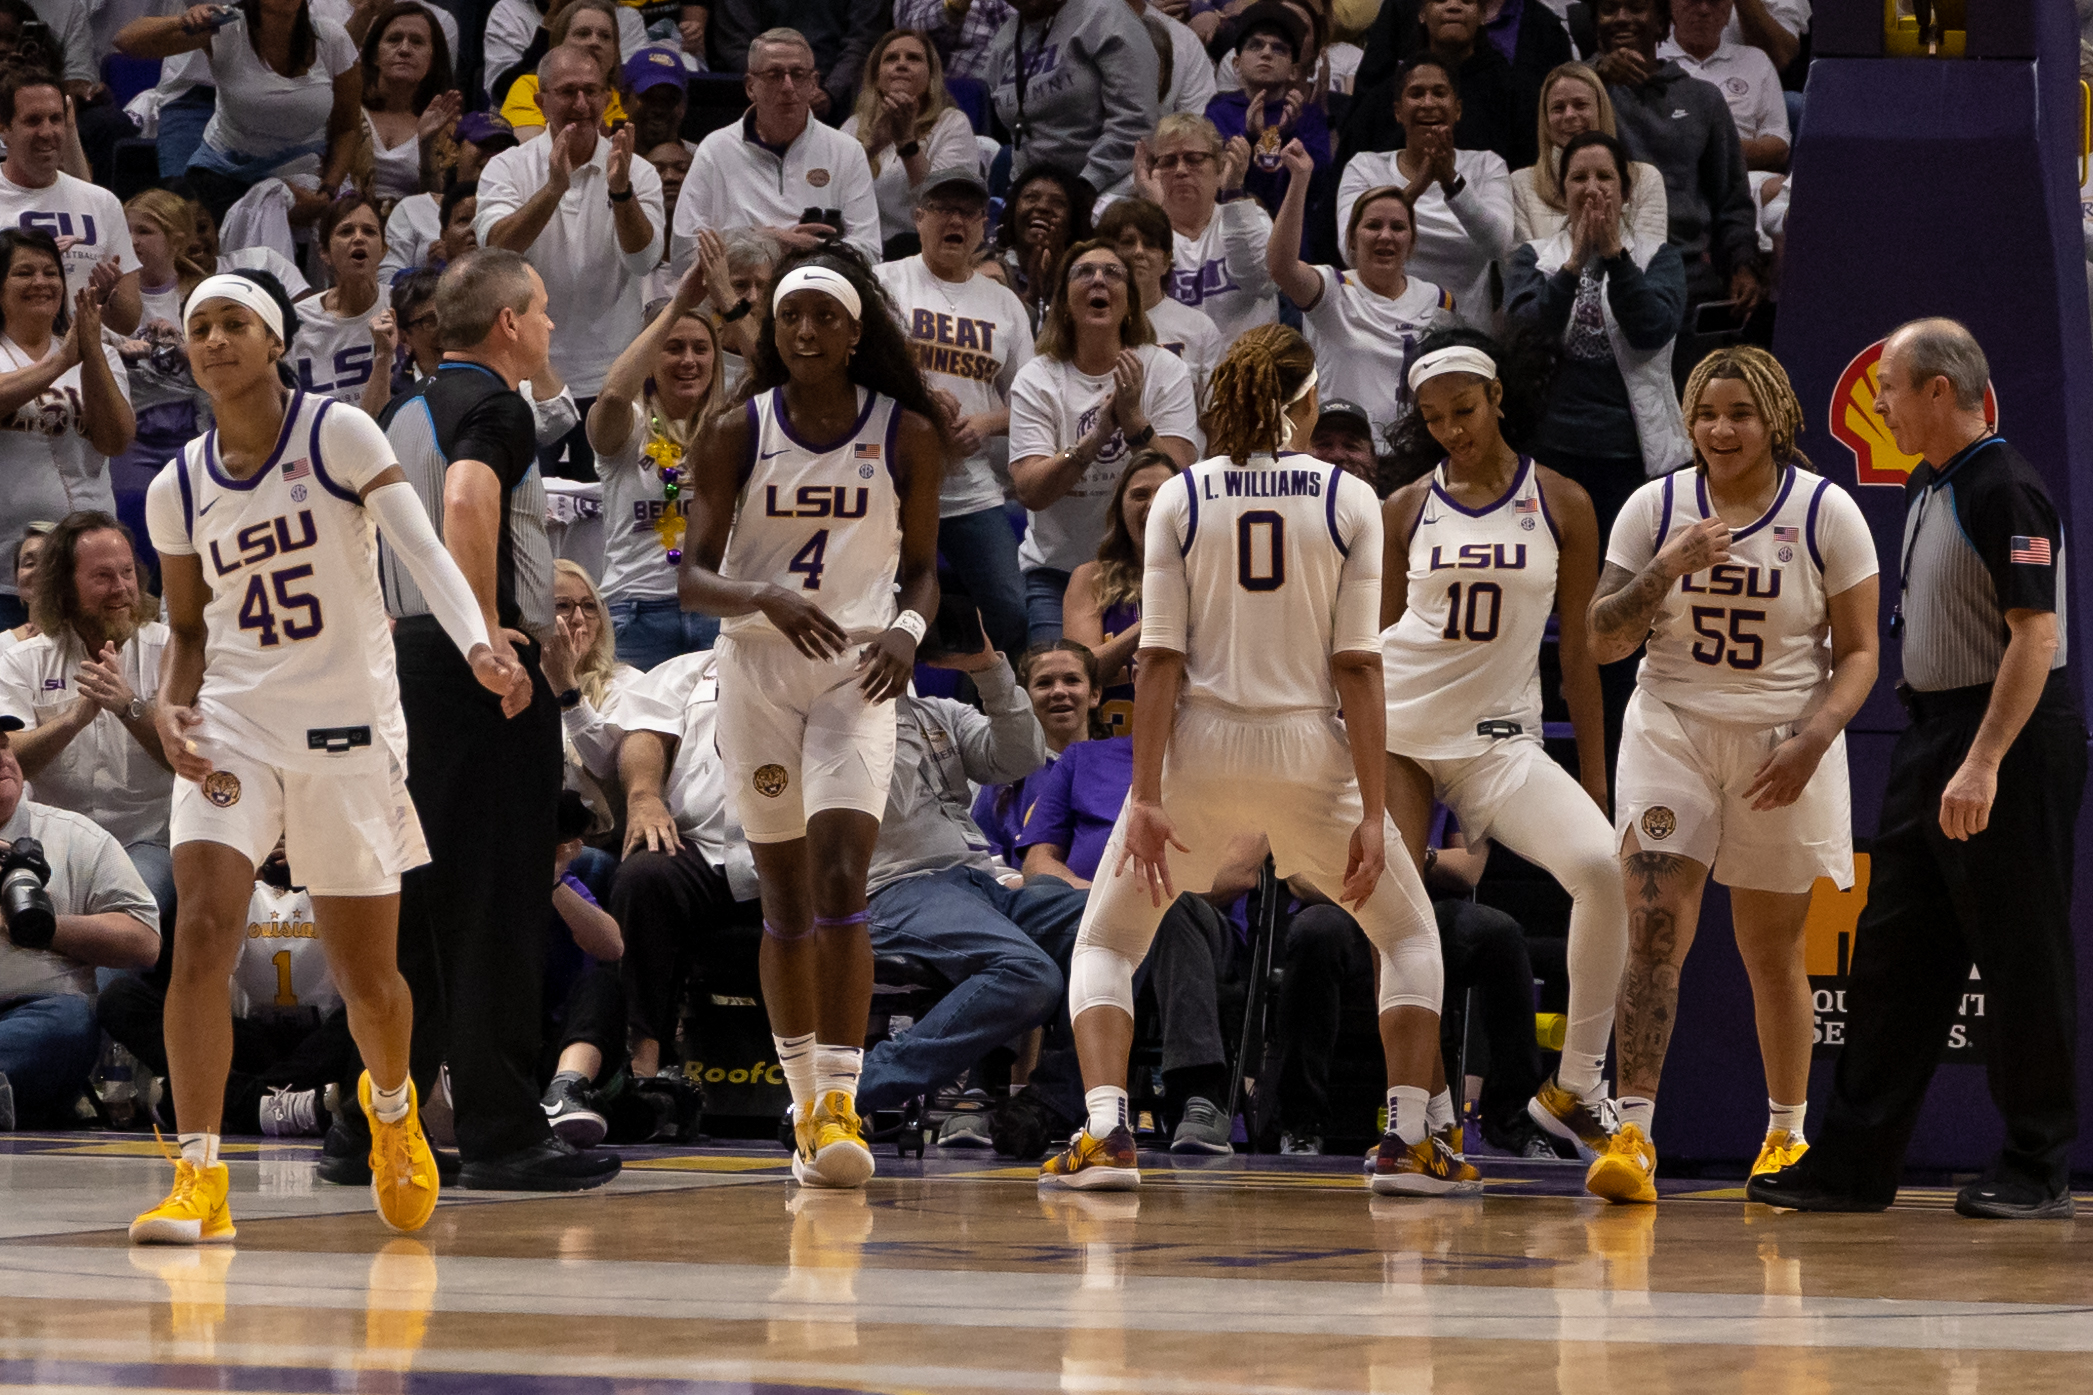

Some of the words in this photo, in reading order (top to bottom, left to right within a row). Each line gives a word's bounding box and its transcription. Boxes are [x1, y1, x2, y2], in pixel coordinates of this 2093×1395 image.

[19, 210, 97, 246] SU
[912, 308, 996, 354] BEAT
[298, 344, 374, 393] LS
[766, 485, 868, 519] LSU
[1204, 474, 1219, 500] L.
[1224, 470, 1321, 498] WILLIAMS
[208, 508, 318, 577] LSU
[788, 529, 829, 590] 4
[1237, 508, 1285, 592] 0
[1430, 542, 1527, 573] LSU
[238, 563, 324, 647] 45
[1681, 563, 1782, 599] LSU
[1443, 581, 1502, 642] 10
[1691, 605, 1766, 671] 55
[272, 949, 298, 1007] 1
